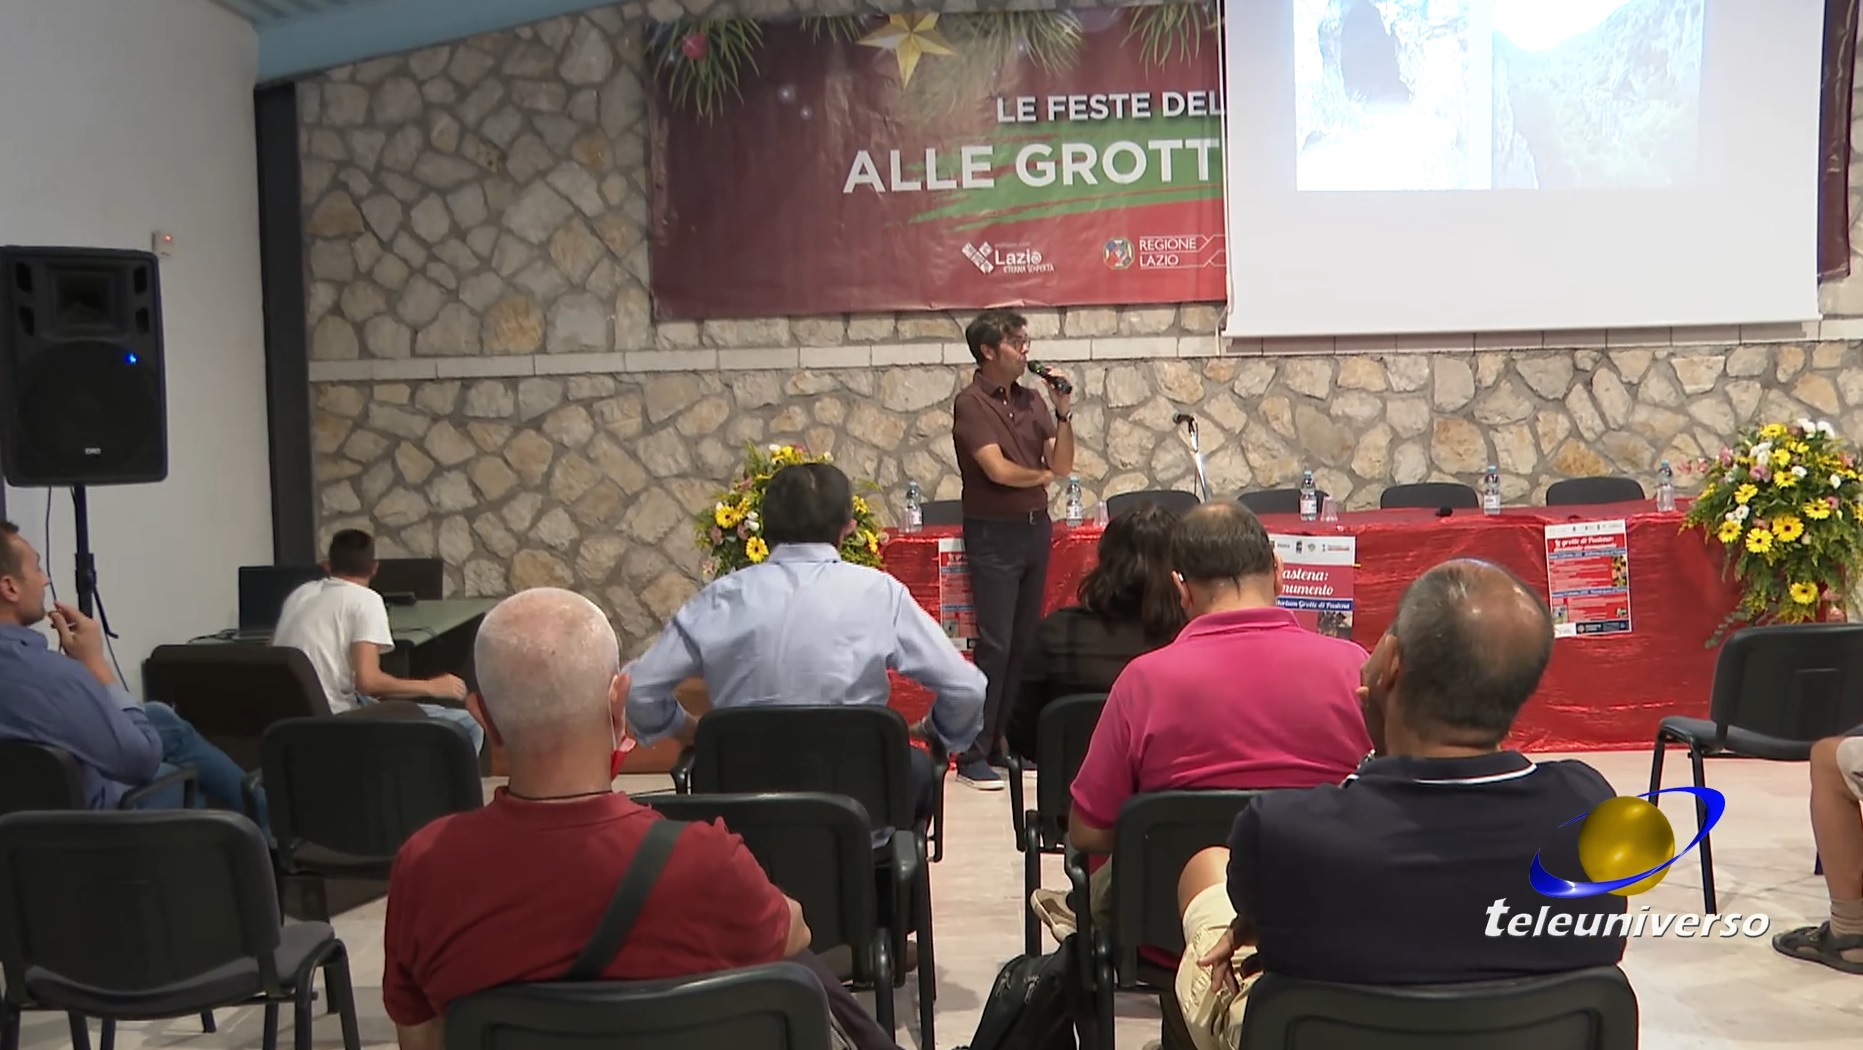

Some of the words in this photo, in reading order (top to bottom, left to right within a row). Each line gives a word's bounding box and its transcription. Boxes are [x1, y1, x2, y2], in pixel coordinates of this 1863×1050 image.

[997, 96, 1037, 122] LE
[1047, 92, 1151, 121] FESTE
[843, 145, 994, 193] ALLE
[1015, 138, 1220, 187] GROTT
[1140, 237, 1197, 251] REGIONE
[1140, 254, 1179, 267] LAZIO
[1282, 568, 1329, 582] astena:
[1282, 584, 1334, 596] numento
